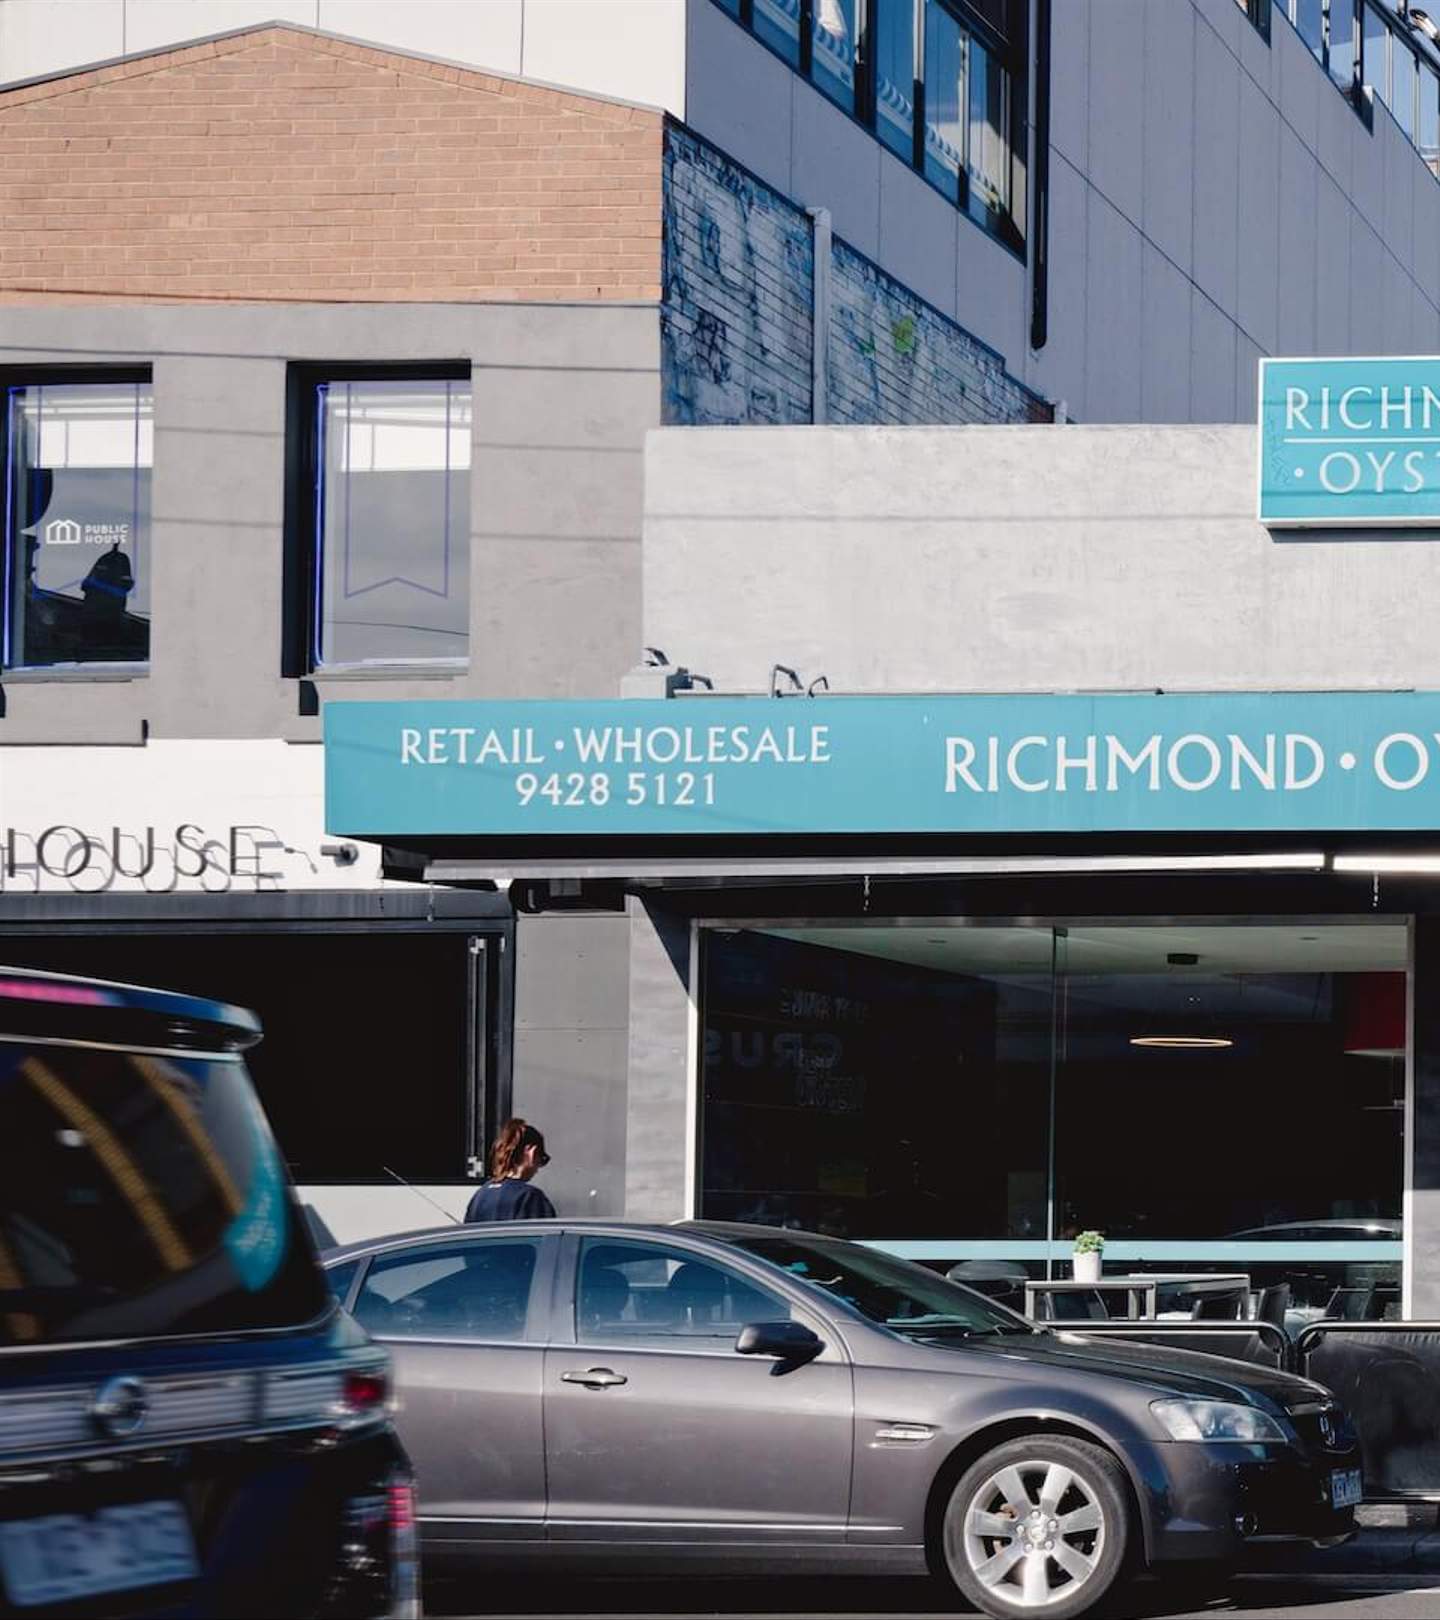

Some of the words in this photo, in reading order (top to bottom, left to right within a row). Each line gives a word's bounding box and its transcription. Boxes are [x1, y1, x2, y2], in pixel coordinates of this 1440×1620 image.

[84, 524, 129, 533] PUBLIC
[84, 535, 127, 544] HOUSE
[400, 728, 545, 764] RETAIL
[573, 725, 831, 763] WHOLESALE
[944, 733, 1325, 793] RICHMOND
[515, 772, 610, 806] 9428
[626, 772, 716, 806] 5121
